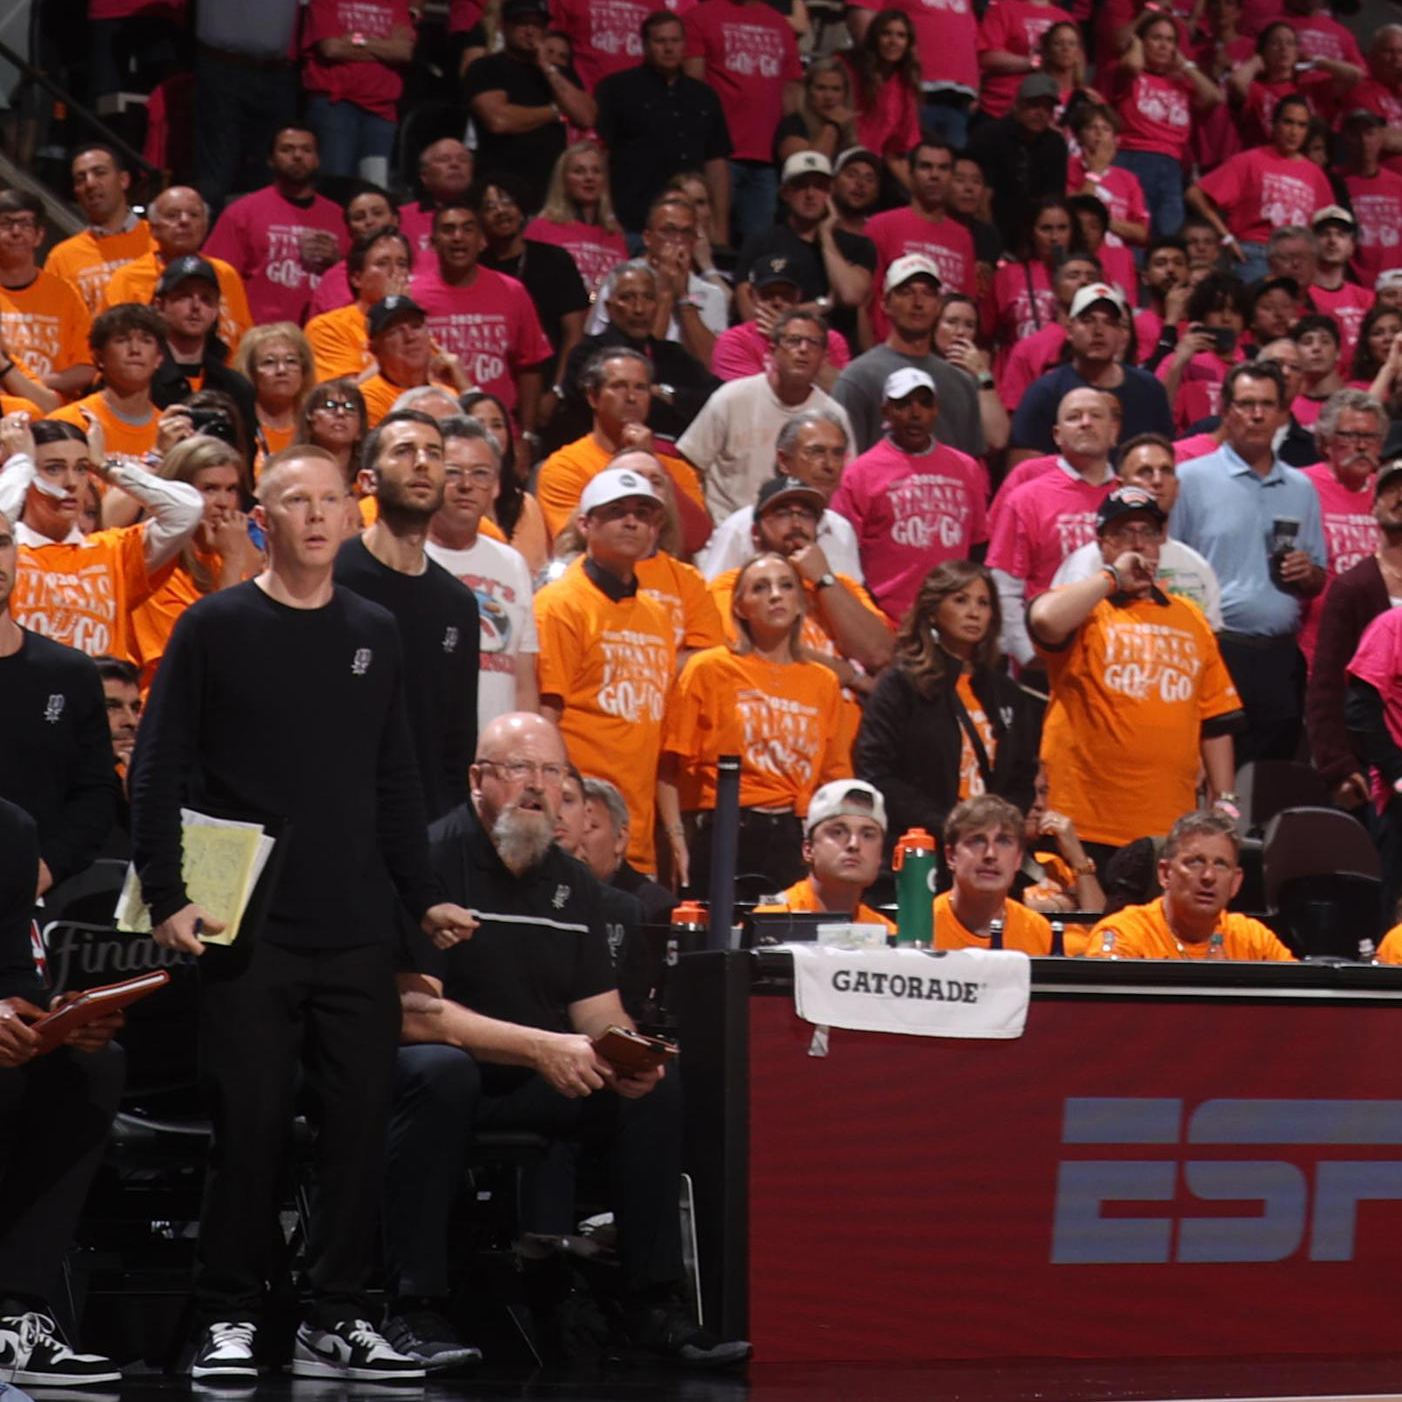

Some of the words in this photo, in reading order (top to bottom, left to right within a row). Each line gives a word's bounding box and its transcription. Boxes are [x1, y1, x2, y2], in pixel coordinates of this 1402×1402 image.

[475, 353, 504, 384] GO
[891, 515, 926, 548] GO
[1104, 663, 1141, 698] GO
[1160, 667, 1193, 703] GO
[598, 681, 636, 722] GO
[832, 969, 980, 1004] GATORADE
